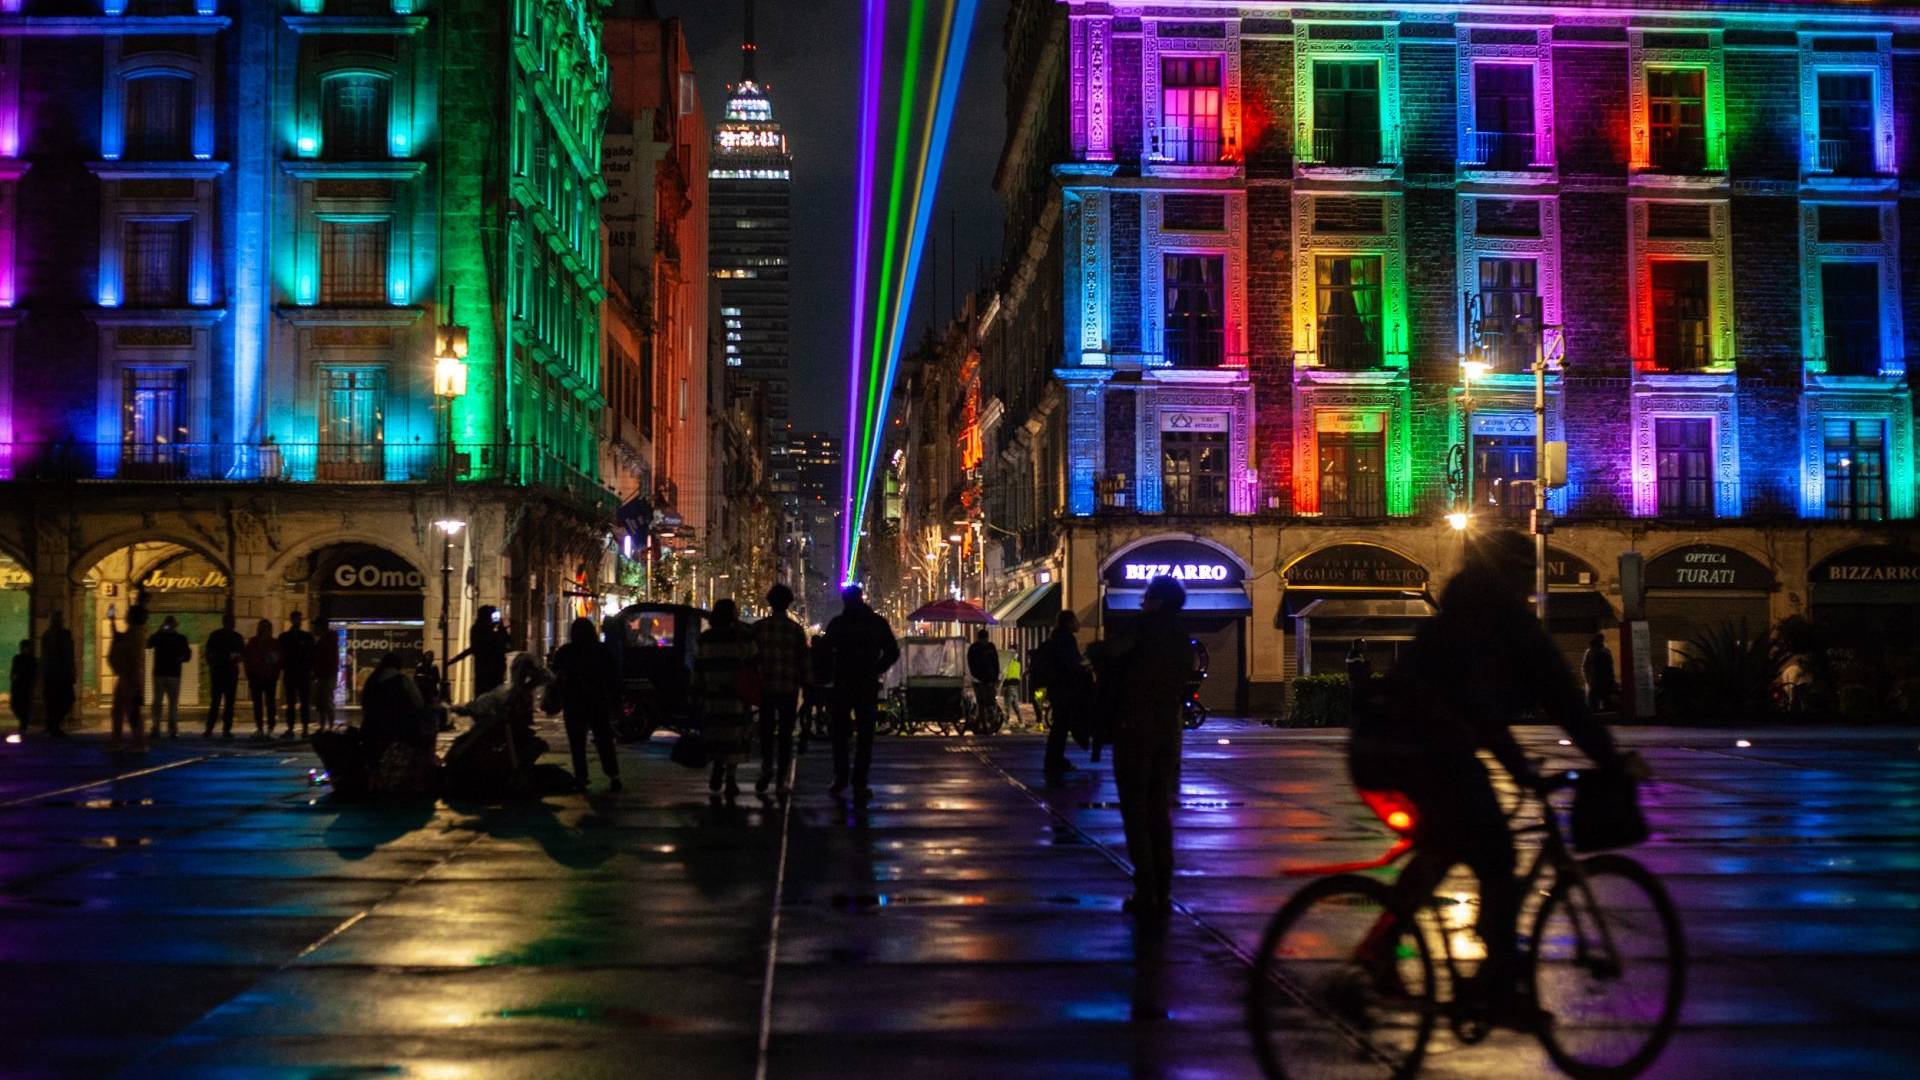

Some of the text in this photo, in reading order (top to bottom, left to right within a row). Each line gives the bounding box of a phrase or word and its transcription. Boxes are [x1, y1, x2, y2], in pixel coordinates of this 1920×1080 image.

[1685, 553, 1727, 563] OPTICA
[1126, 564, 1227, 580] BIZZARRO
[1677, 569, 1736, 584] TURATI
